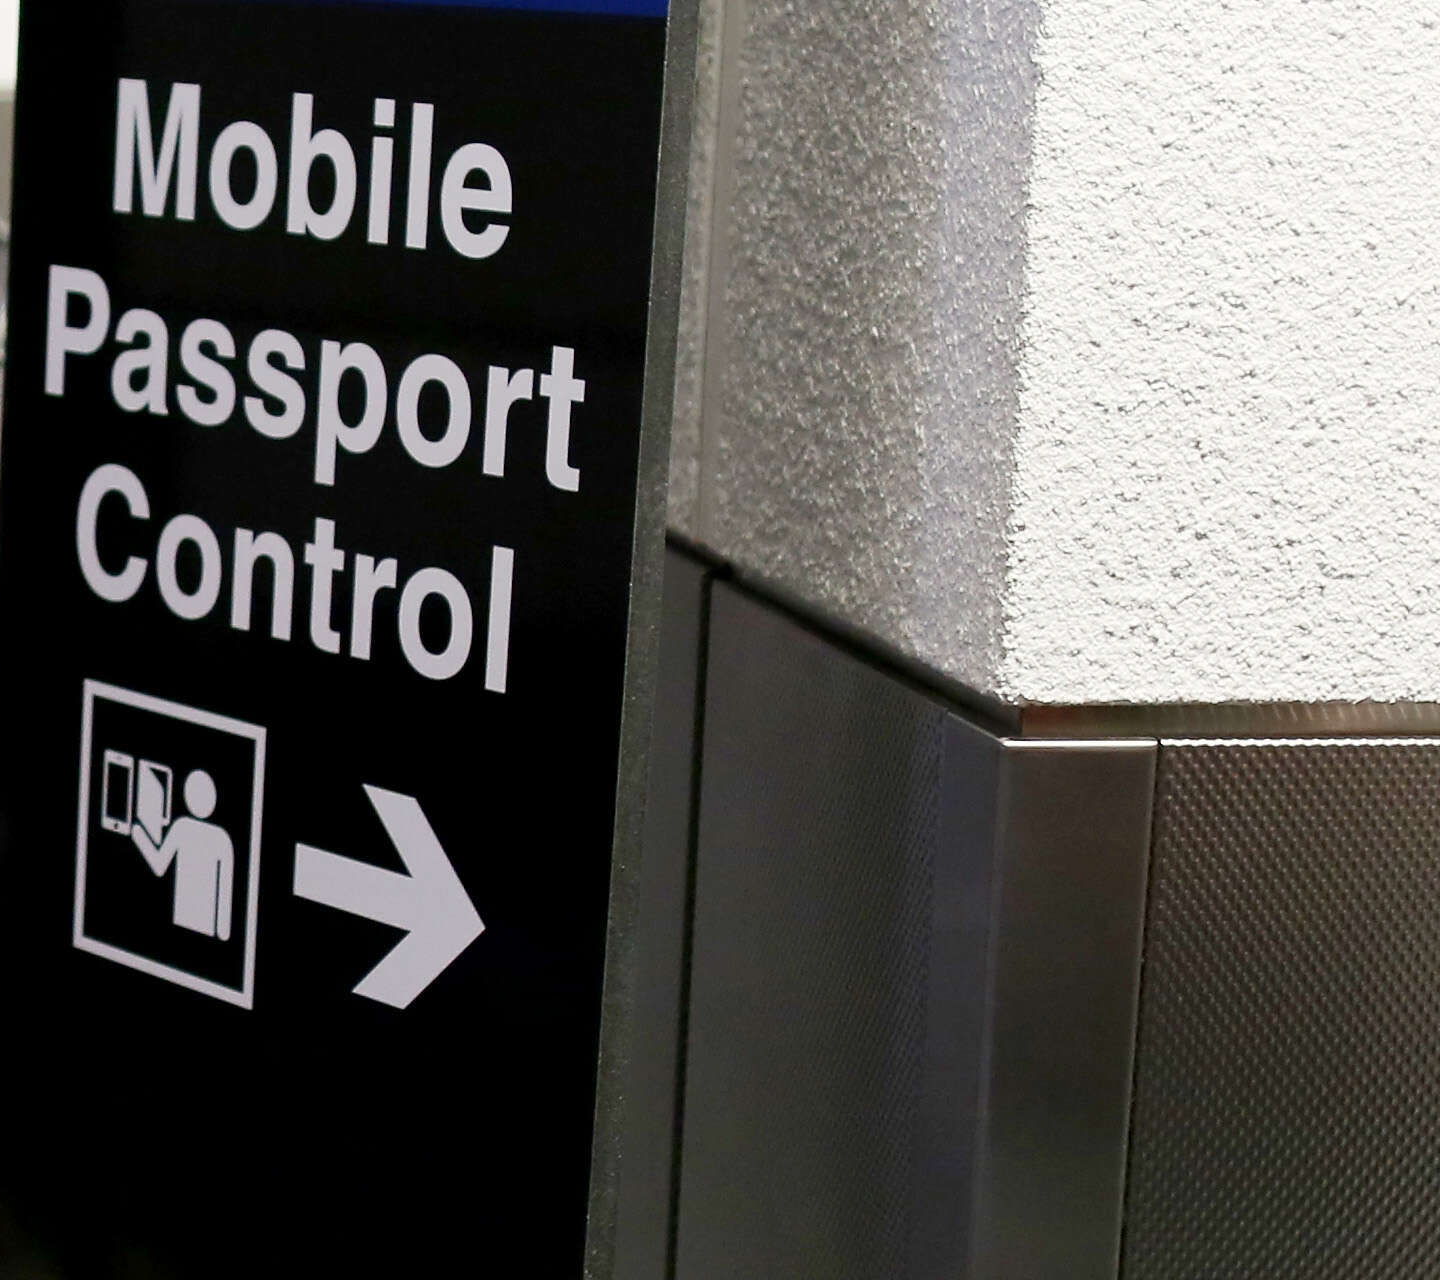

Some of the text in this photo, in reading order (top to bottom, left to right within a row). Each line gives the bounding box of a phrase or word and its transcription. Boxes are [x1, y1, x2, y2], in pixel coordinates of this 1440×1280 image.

[113, 77, 514, 259] Mobile
[45, 263, 586, 492] Passport
[76, 462, 515, 694] Control
